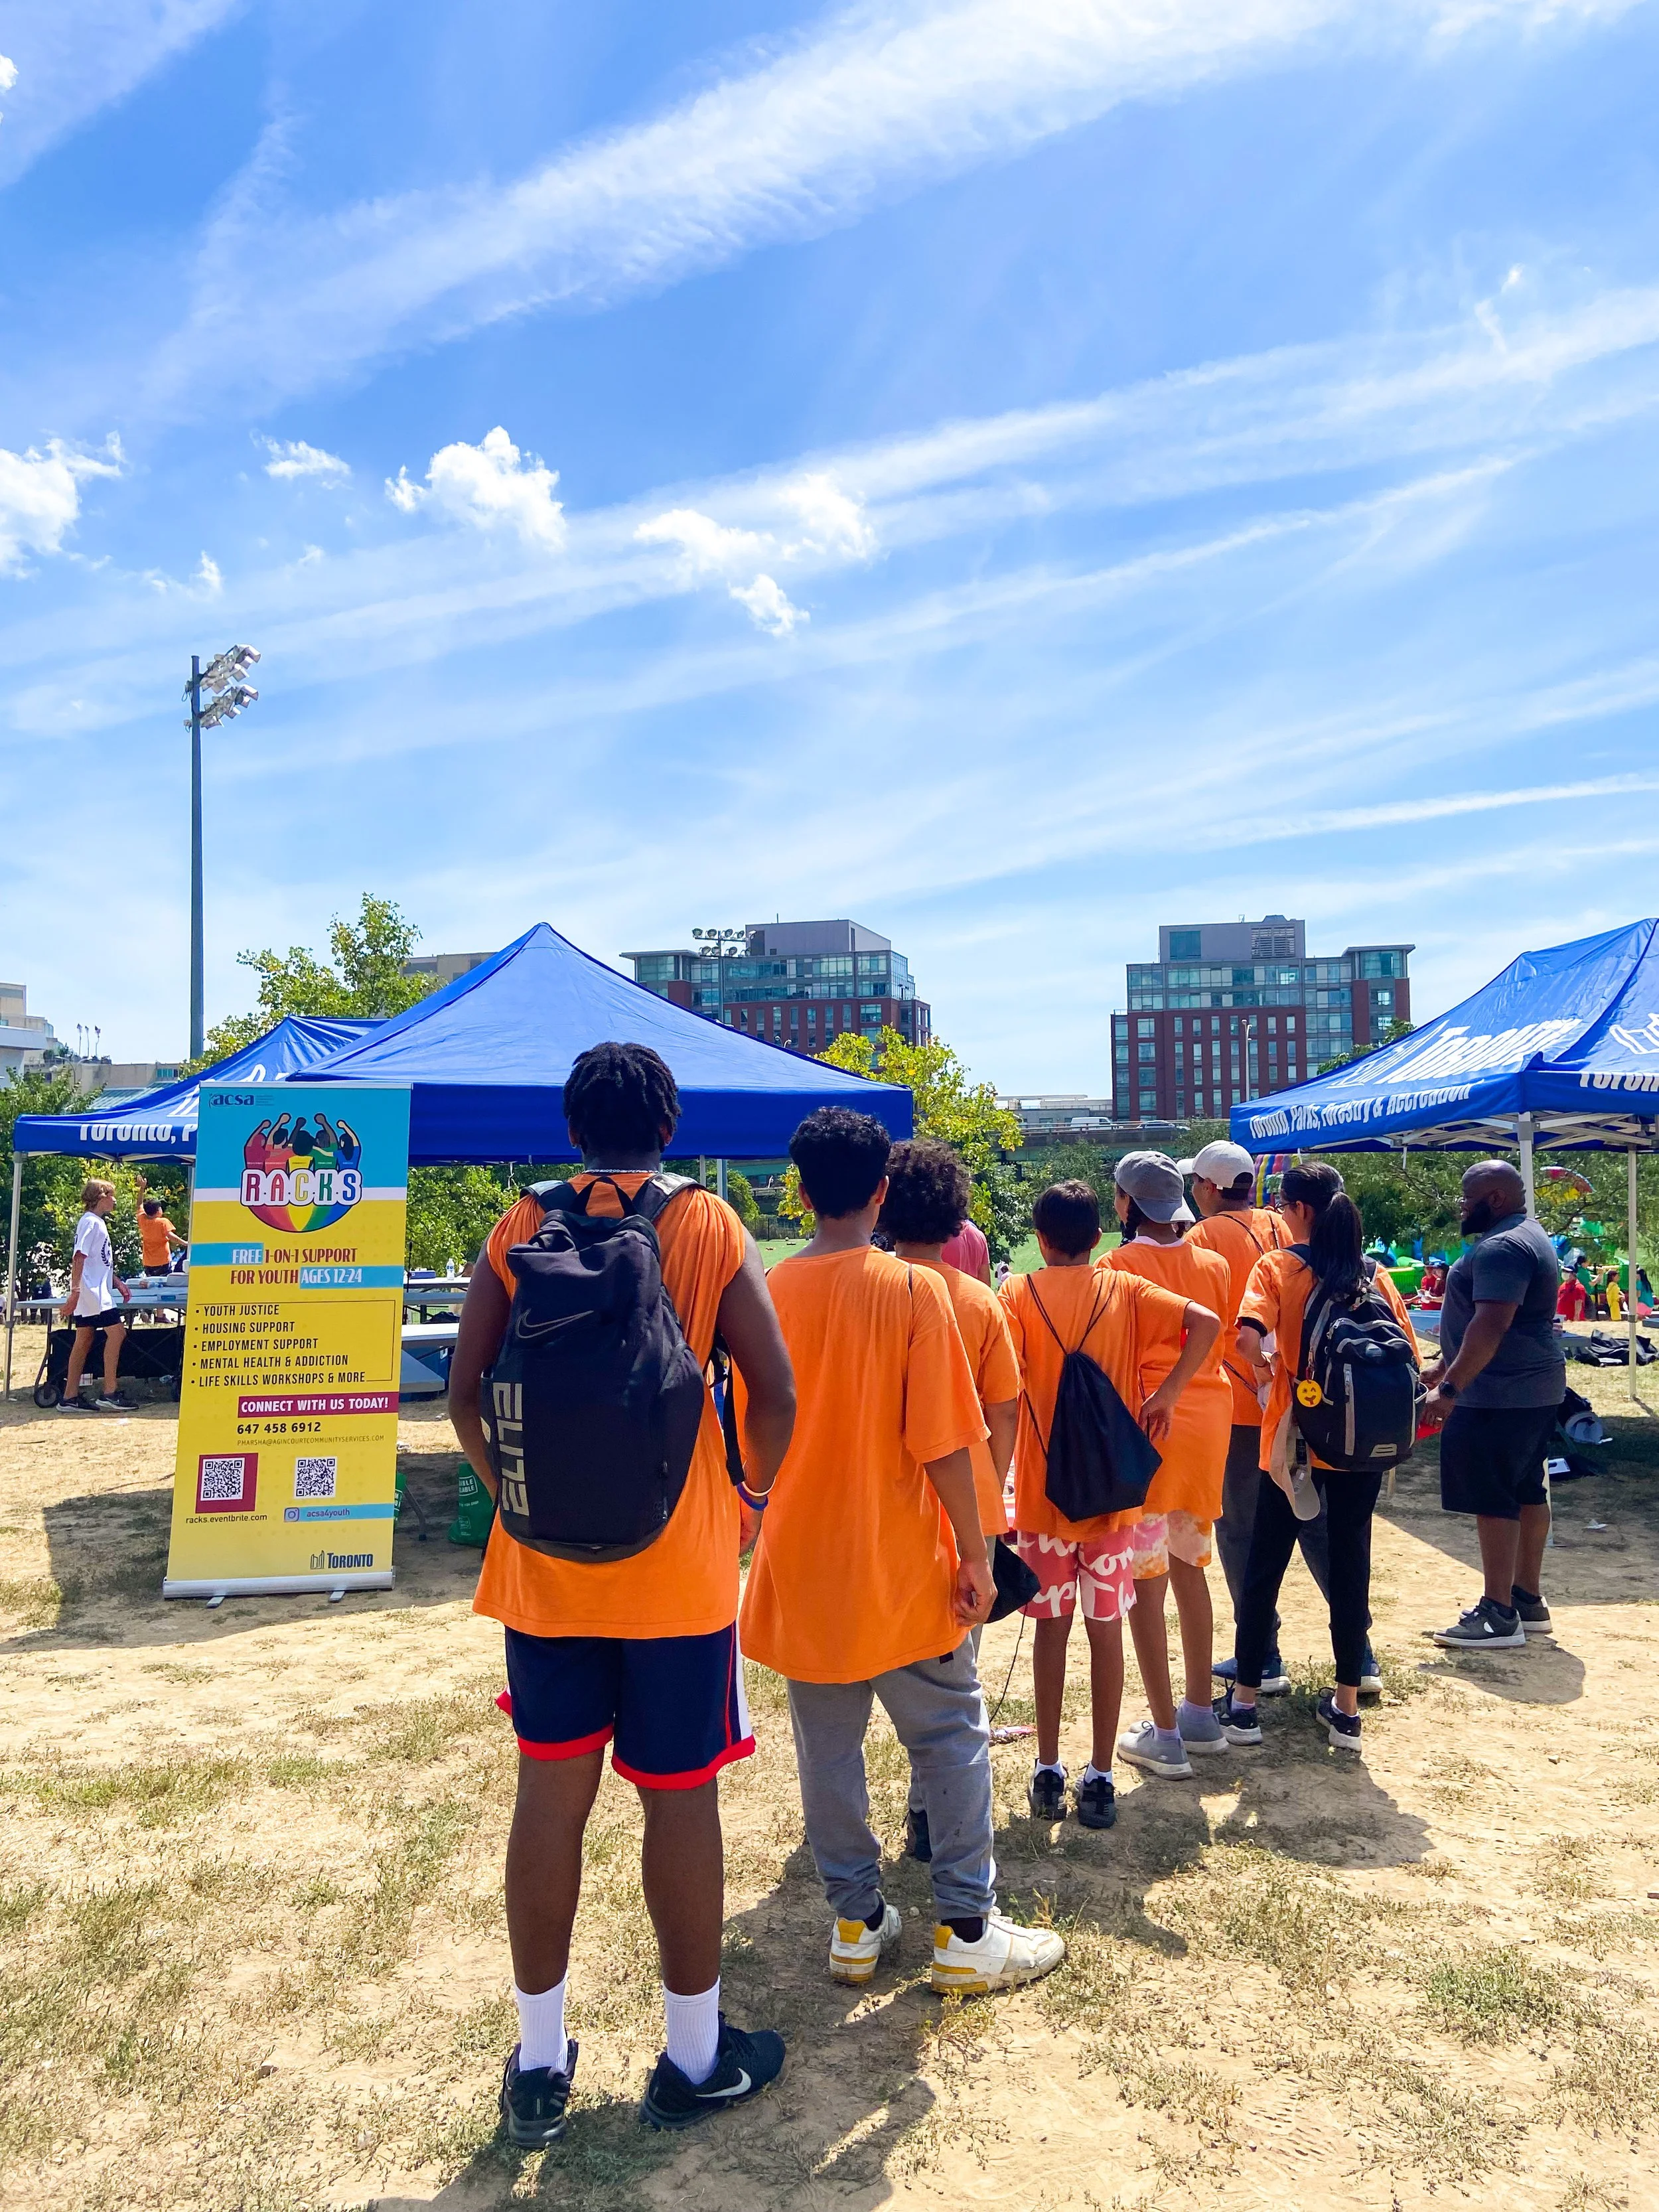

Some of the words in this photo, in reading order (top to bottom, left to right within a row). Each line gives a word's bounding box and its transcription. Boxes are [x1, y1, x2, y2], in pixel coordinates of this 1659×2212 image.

[1579, 1071, 1659, 1092] Toron
[213, 1094, 254, 1106] acsa
[1372, 1096, 1386, 1118] &
[80, 1124, 176, 1144] Toronto,
[232, 1249, 263, 1264] FREE
[265, 1249, 299, 1263] 1-ON-1
[301, 1248, 358, 1263] SUPPORT
[231, 1270, 255, 1284] FOR
[258, 1269, 299, 1284] YOUTH
[301, 1269, 331, 1284] AGES
[333, 1268, 362, 1283] 12-24
[204, 1305, 236, 1316] YOUTH
[239, 1305, 279, 1315] JUSTICE
[202, 1323, 246, 1334] HOUSING
[250, 1321, 295, 1333] SUPPORT
[202, 1339, 269, 1351] EMPLOYMENT
[273, 1338, 319, 1349] SUPPORT
[200, 1357, 239, 1369] MENTAL
[244, 1357, 281, 1368] HEALTH
[285, 1357, 291, 1366] &
[295, 1355, 348, 1366] ADDICTION
[199, 1376, 220, 1387] LIFE
[224, 1374, 259, 1386] SKILLS
[263, 1373, 324, 1384] WORKSHOPS
[328, 1372, 334, 1383] &
[338, 1372, 365, 1382] MORE
[241, 1400, 293, 1412] CONNECT
[297, 1399, 326, 1411] WITH
[330, 1398, 344, 1410] US
[348, 1397, 388, 1409] TODAY!
[237, 1424, 259, 1434] 647
[263, 1423, 287, 1434] 458
[291, 1422, 321, 1432] 6912
[492, 1382, 530, 1516] ELITE
[186, 1514, 267, 1524] racks.eventbrite.com
[307, 1509, 350, 1518] acsa4youth
[326, 1552, 374, 1569] TORONTO
